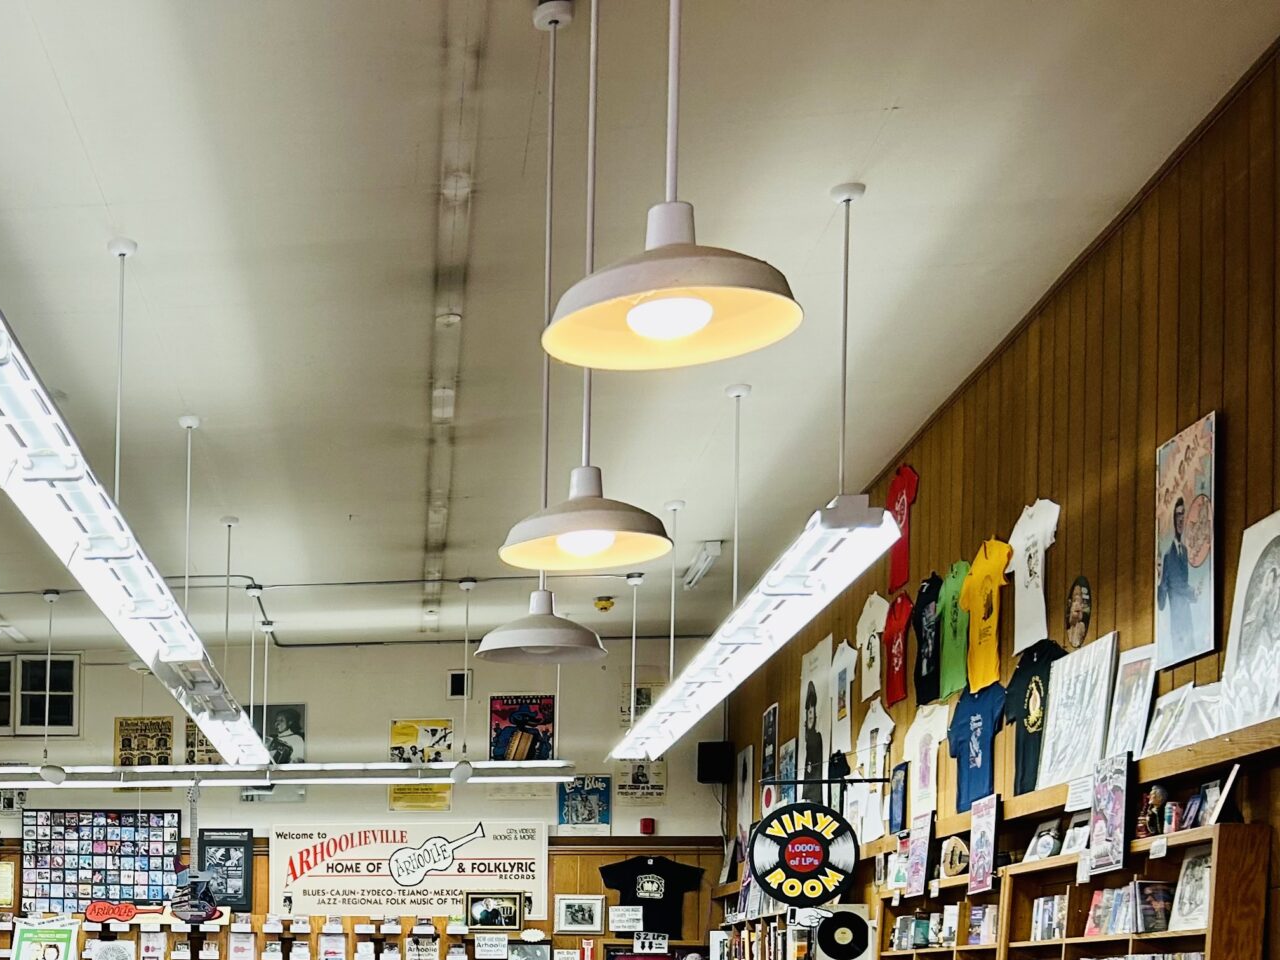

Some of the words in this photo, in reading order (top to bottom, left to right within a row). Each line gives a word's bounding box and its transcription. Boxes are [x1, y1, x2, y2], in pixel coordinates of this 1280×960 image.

[765, 810, 840, 840] VINYL
[275, 831, 315, 840] Welcome
[317, 832, 327, 840] to
[787, 843, 821, 854] 1,000's
[285, 829, 409, 888] ARHOOLIEVILLE
[396, 842, 451, 878] ARHOOLIE
[790, 857, 799, 866] of
[326, 862, 363, 873] HOME
[366, 862, 383, 873] OF
[457, 862, 466, 873] &
[471, 862, 536, 873] FOLKLYRIC
[499, 873, 536, 881] RECORDS
[765, 867, 845, 898] ROOM
[302, 889, 326, 897] BLUES
[330, 889, 357, 897] CAJUN
[361, 889, 393, 897] ZYDECO
[397, 889, 429, 897] TEJANO
[433, 889, 465, 897] MEXICA
[317, 897, 337, 905] JAZZ
[341, 897, 382, 905] REGIONAL
[386, 897, 407, 905] FOLK
[410, 897, 433, 905] MUSIC
[436, 897, 447, 905] OF
